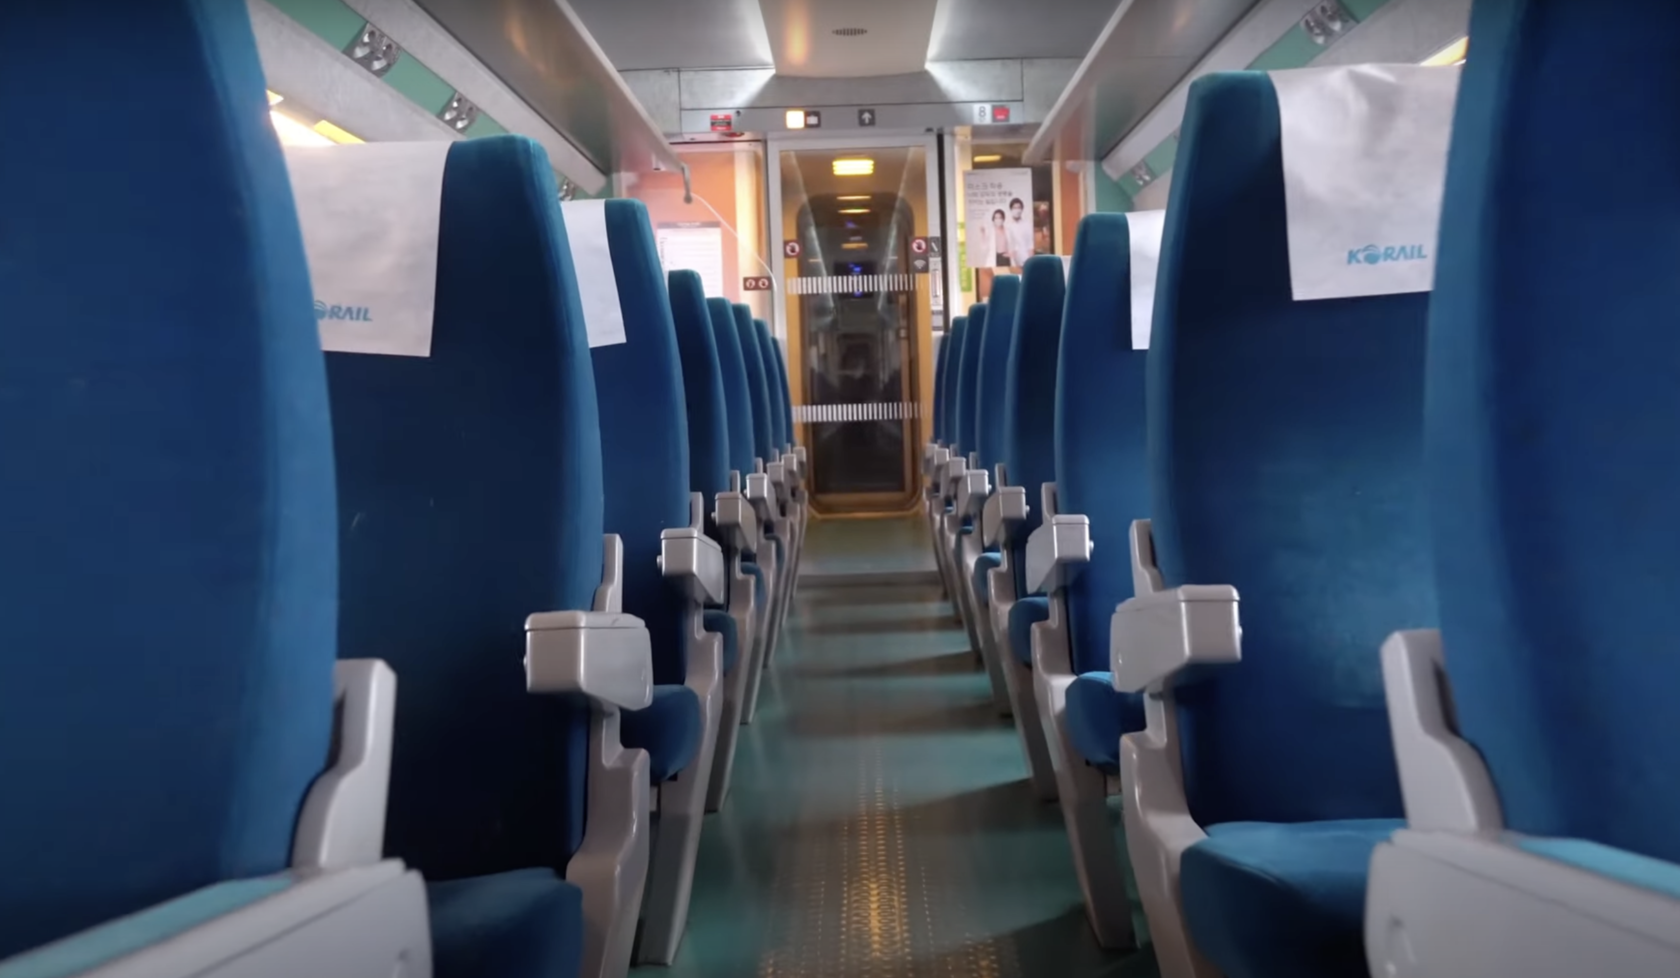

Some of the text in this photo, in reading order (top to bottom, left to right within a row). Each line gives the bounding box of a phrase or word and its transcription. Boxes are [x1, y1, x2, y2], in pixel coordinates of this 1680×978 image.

[978, 105, 987, 118] 8
[1347, 244, 1427, 265] KORAIL
[314, 300, 373, 321] ORAIL
